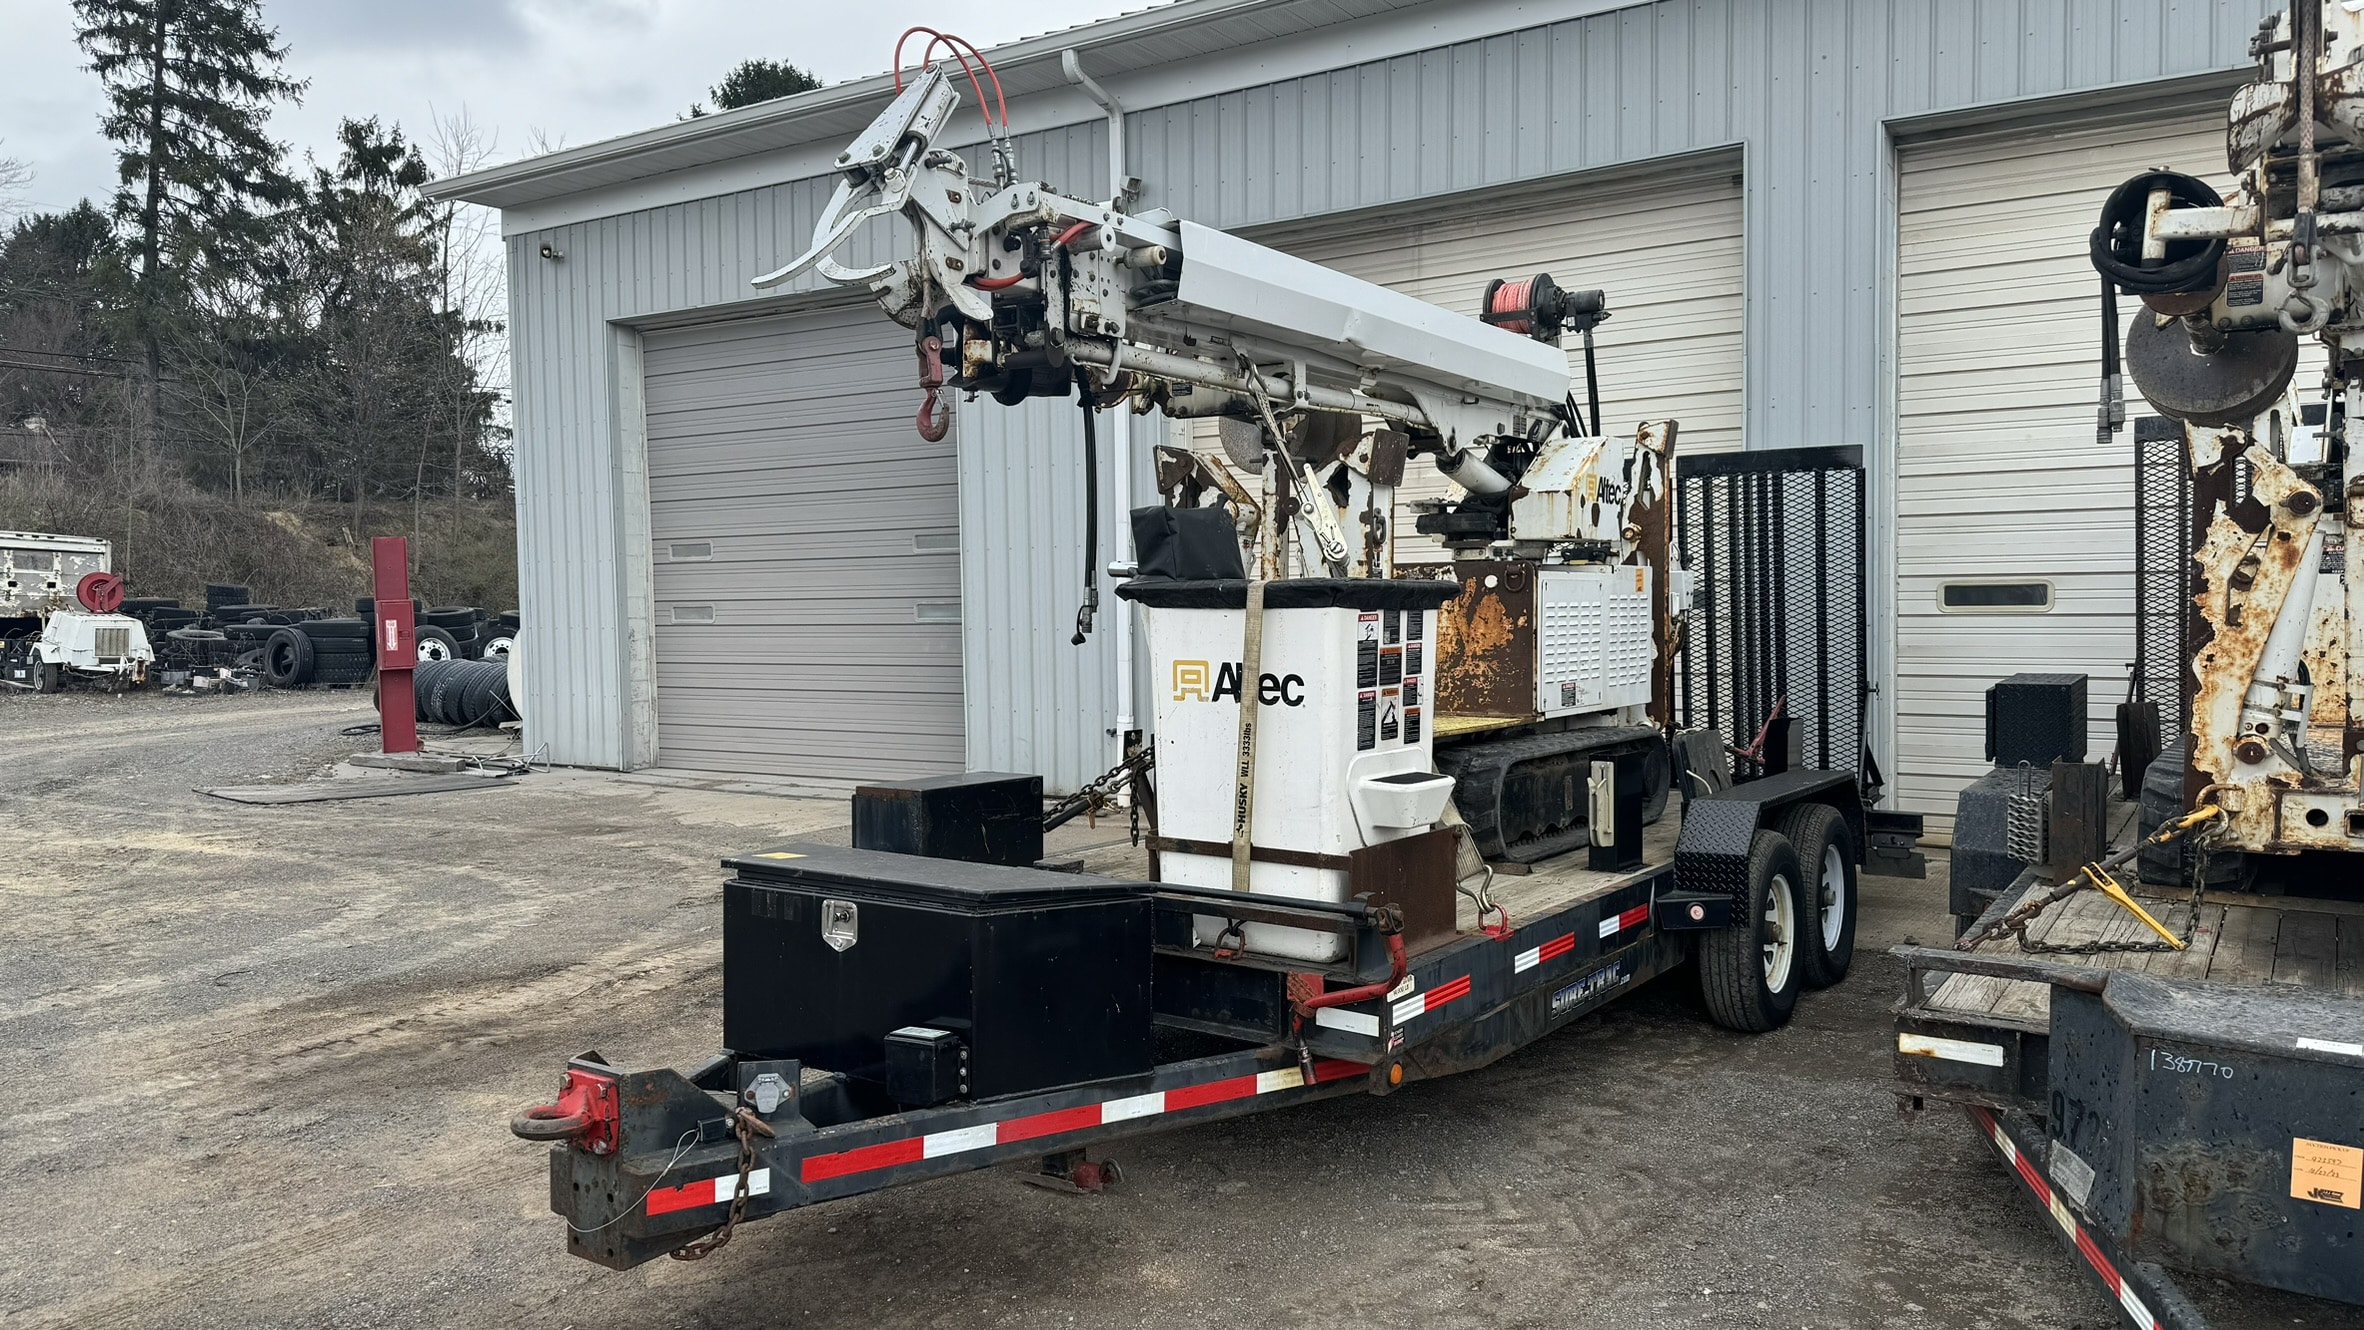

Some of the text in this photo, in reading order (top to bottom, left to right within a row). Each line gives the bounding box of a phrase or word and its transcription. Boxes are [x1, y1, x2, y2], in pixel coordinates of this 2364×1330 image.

[2235, 245, 2265, 254] DANGER
[1596, 475, 1621, 505] Altec
[1211, 661, 1305, 707] Alec
[1237, 722, 1252, 824] HUSKY WLL 3333lbs
